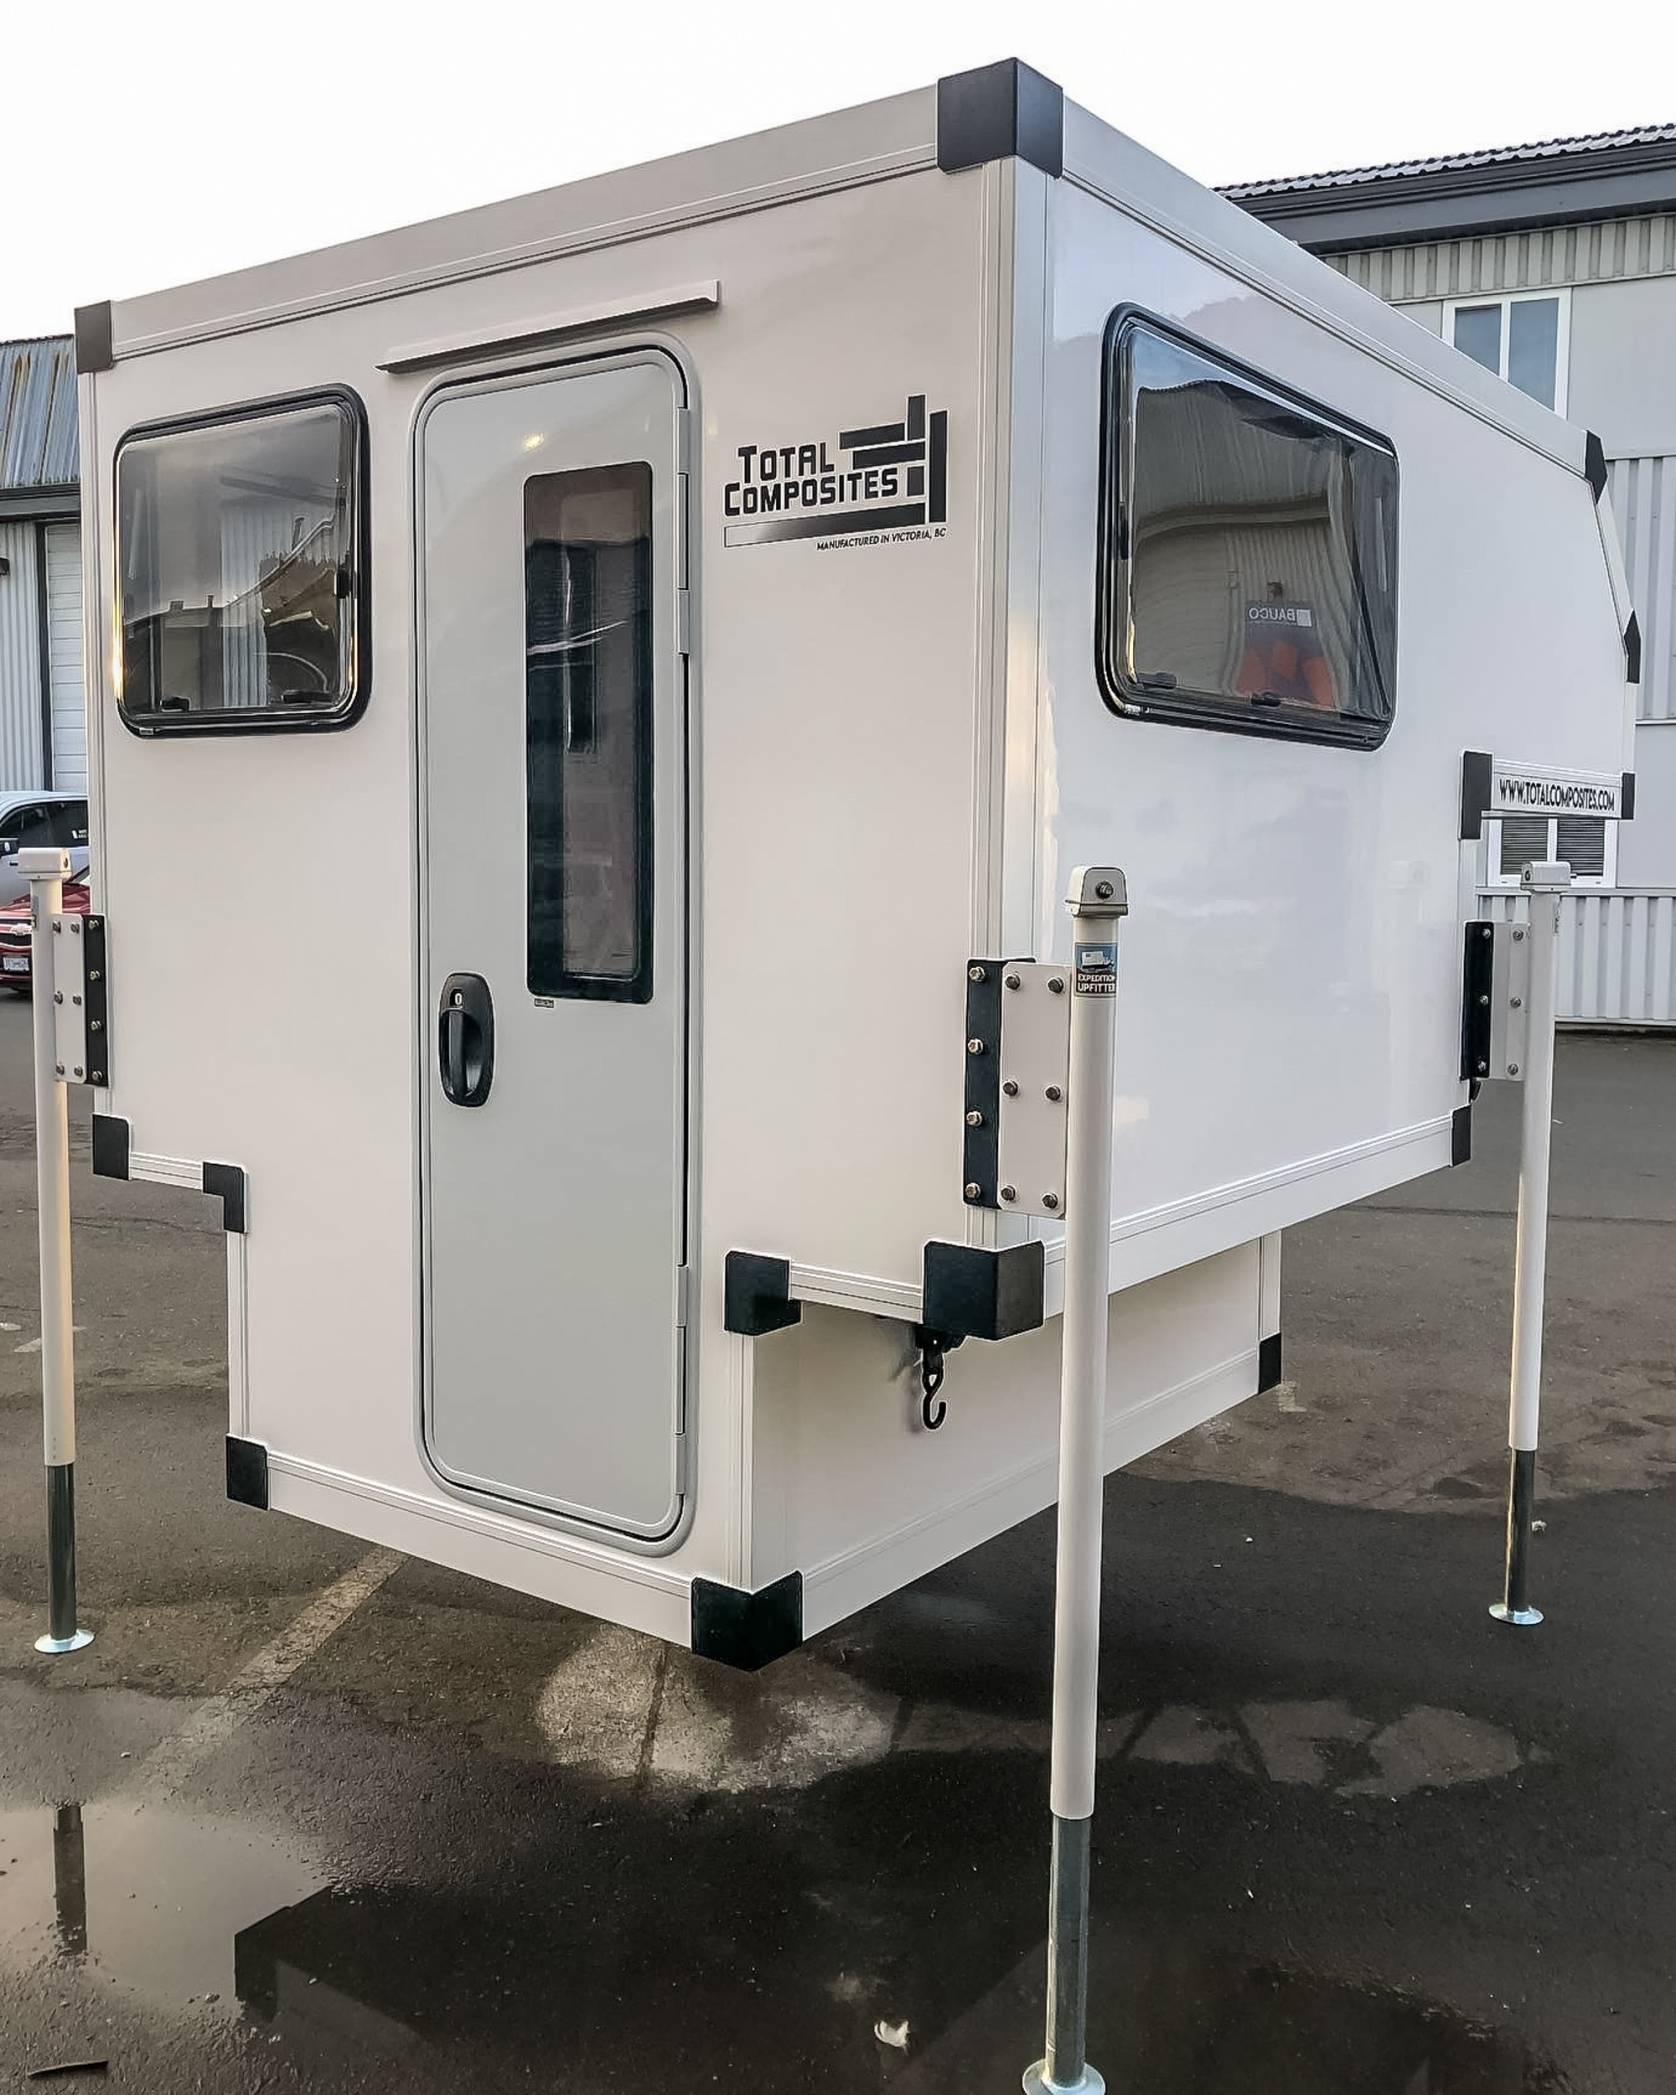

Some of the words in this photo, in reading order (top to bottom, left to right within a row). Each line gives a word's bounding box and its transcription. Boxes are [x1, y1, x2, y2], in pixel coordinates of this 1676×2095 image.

[738, 442, 835, 484] TOTAL
[724, 467, 898, 517] COMPOSITES
[816, 536, 880, 550] MANUFACTURED
[880, 534, 890, 543] IN
[891, 529, 933, 542] VICTORIA,
[934, 527, 947, 538] BC
[1499, 778, 1615, 811] WWW.TOTALCOMPOSITES.COM
